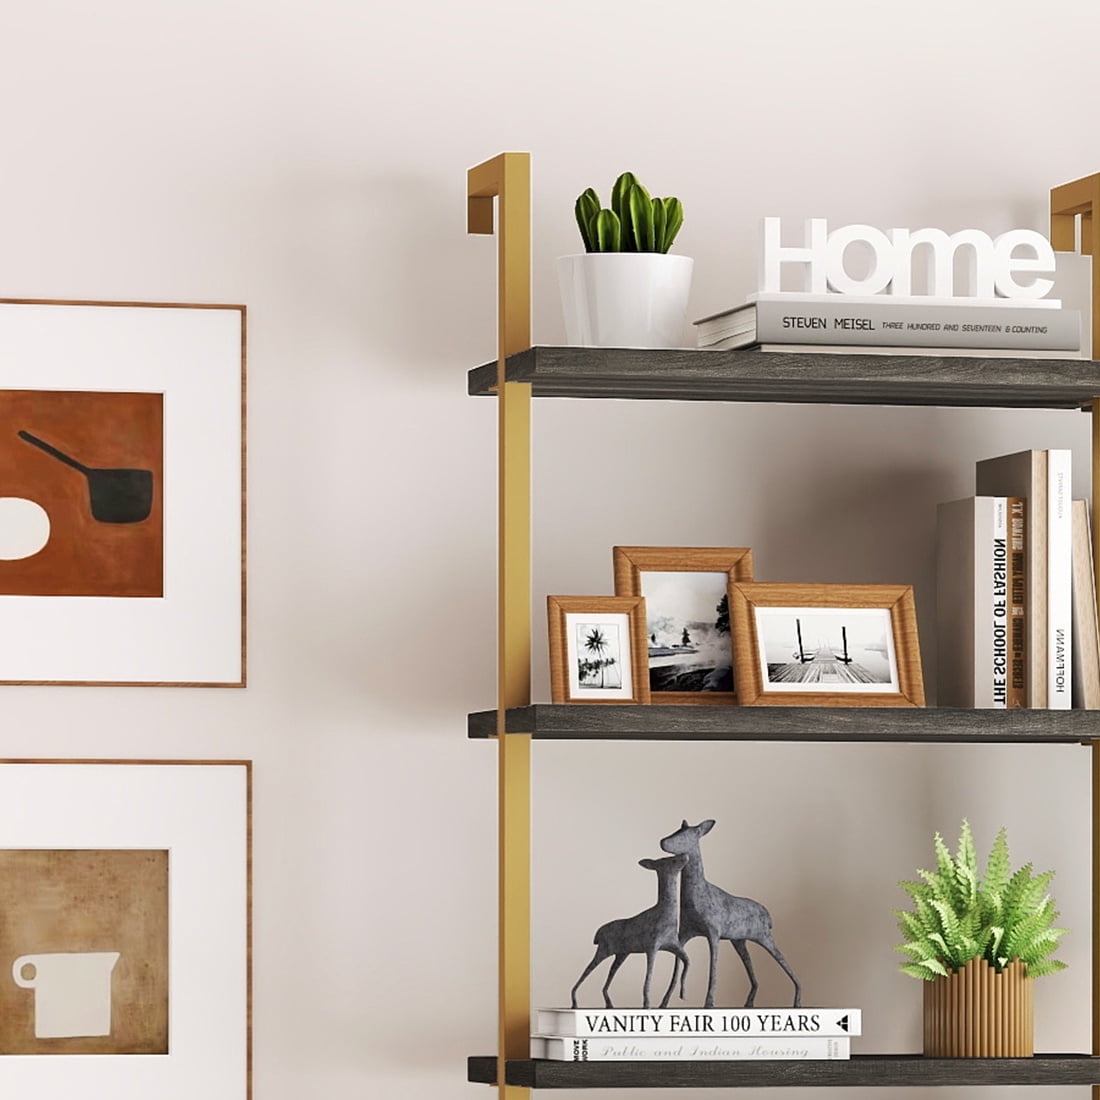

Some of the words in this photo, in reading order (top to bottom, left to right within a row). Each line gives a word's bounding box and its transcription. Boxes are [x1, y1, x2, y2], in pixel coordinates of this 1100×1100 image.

[763, 216, 1057, 300] Home
[782, 316, 827, 329] STEVEN
[834, 318, 875, 331] MEISEL
[882, 321, 904, 330] THREE
[907, 323, 941, 331] HUNDRED
[943, 323, 959, 332] AND
[962, 324, 1001, 333] SEVENTEEN
[1012, 325, 1048, 334] COUNTING
[585, 1014, 664, 1033] VANITY
[669, 1014, 715, 1033] FAIR
[720, 1014, 751, 1033] 100
[756, 1014, 821, 1033] YEARS
[601, 1046, 646, 1057] Public
[654, 1046, 683, 1057] and
[747, 1045, 809, 1058] Housing
